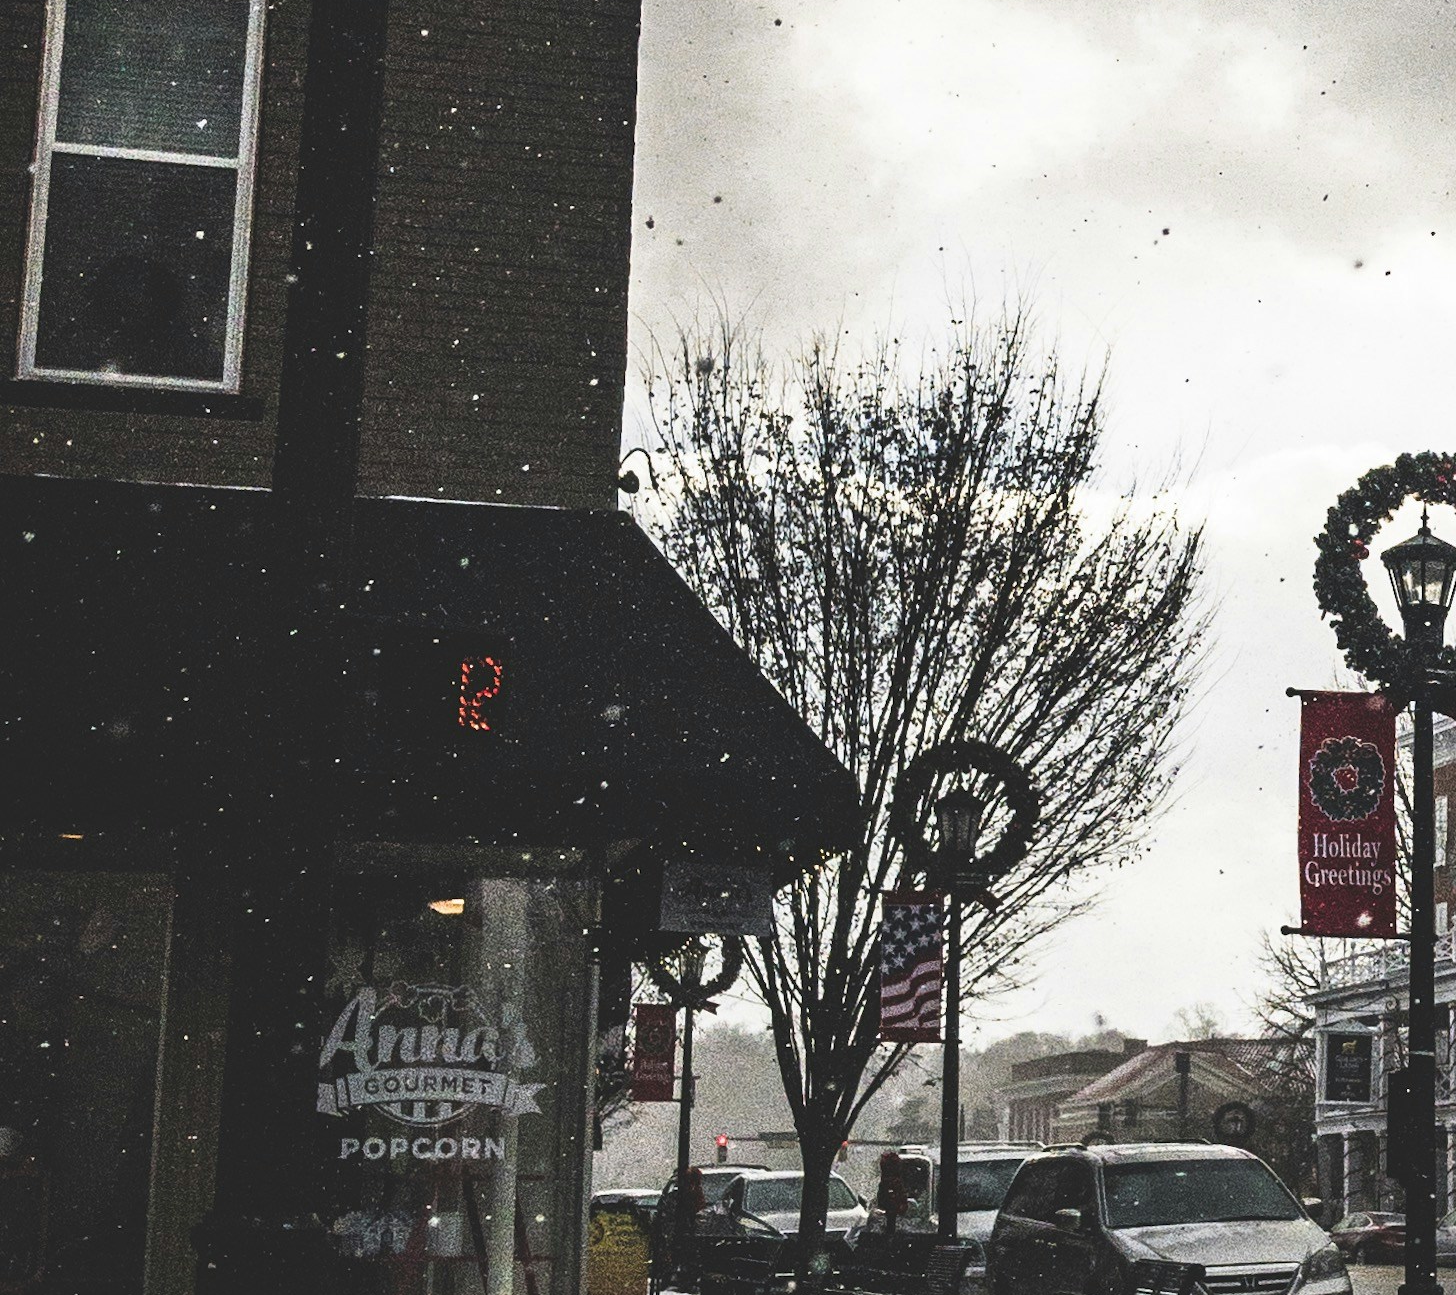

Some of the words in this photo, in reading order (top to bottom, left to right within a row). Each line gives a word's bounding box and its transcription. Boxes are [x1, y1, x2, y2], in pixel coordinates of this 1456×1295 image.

[1313, 833, 1381, 865] Holiday
[1304, 861, 1391, 895] Greetings
[319, 986, 537, 1073] Anna's
[362, 1075, 493, 1096] GOURMET
[339, 1136, 506, 1160] POPCORN
